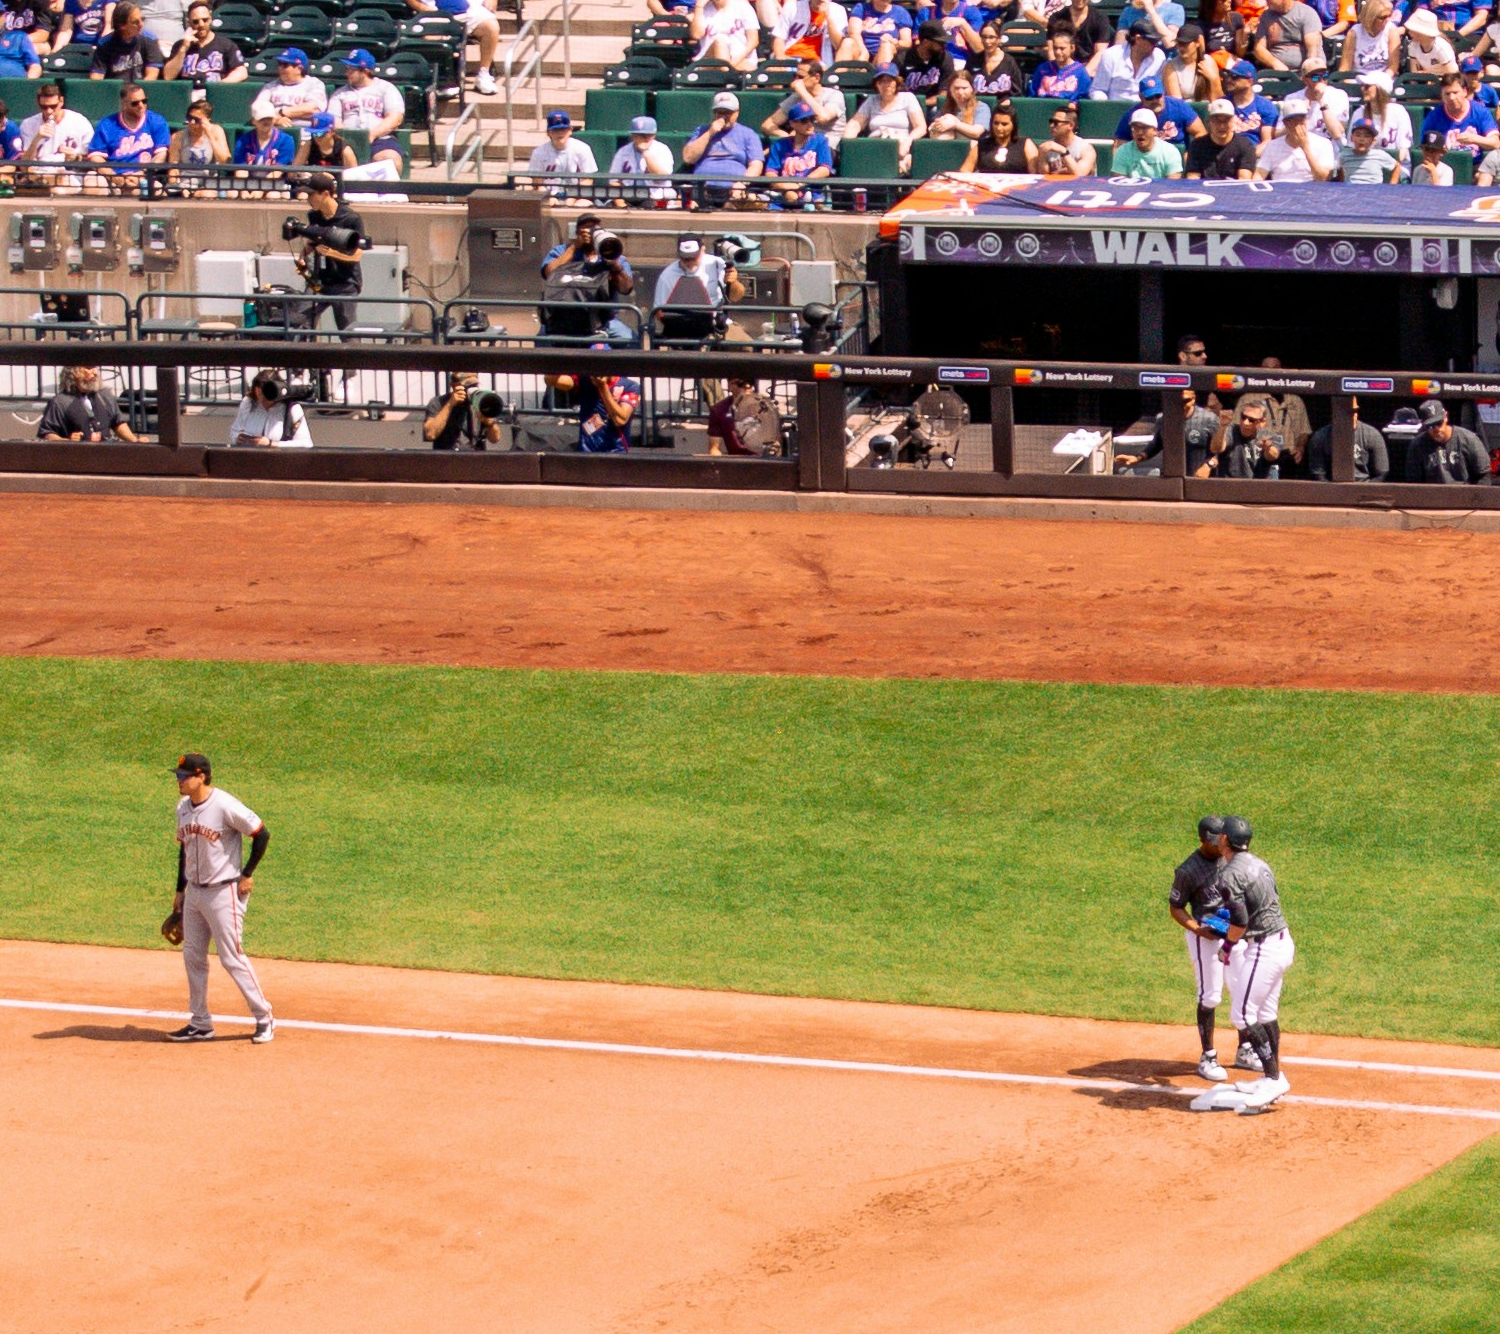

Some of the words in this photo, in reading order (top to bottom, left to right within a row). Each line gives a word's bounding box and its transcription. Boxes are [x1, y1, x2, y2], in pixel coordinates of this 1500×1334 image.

[1091, 230, 1245, 267] WALK
[883, 368, 912, 377] Lottery
[1046, 372, 1064, 380] New
[1065, 373, 1083, 381] York
[1084, 373, 1113, 382] Lottery
[1248, 378, 1266, 386] New
[1267, 379, 1285, 387] York
[1286, 379, 1315, 388] Lottery
[1444, 383, 1462, 391] New
[1463, 384, 1481, 392] York
